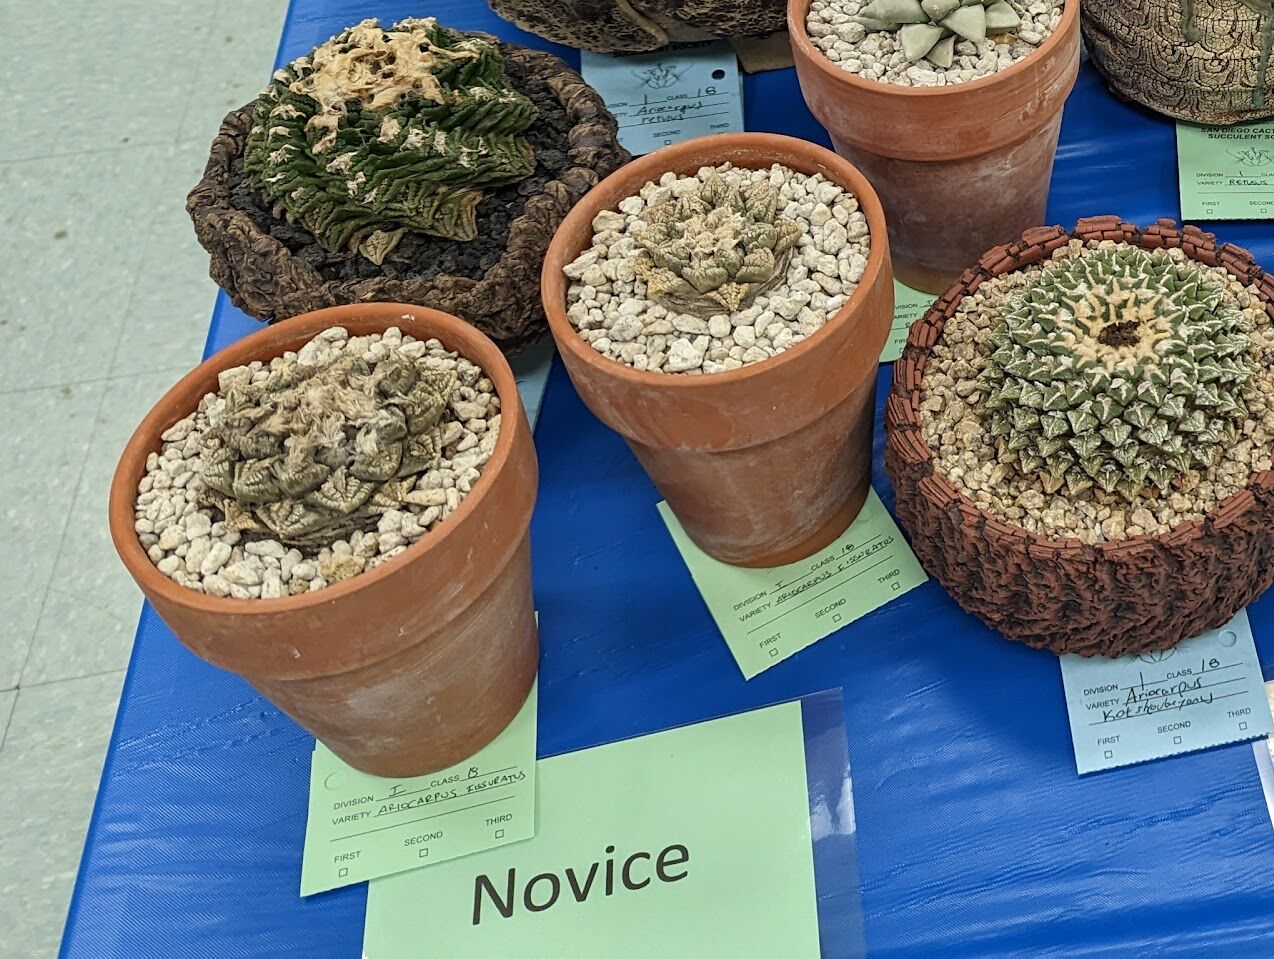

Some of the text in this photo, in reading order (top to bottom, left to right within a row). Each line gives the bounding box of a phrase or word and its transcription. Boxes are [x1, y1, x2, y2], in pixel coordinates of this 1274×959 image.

[653, 122, 731, 138] SECOND THIRD
[733, 590, 768, 612] DIVISION
[810, 554, 836, 573] CLASS
[738, 601, 774, 623] VARIETY
[759, 568, 901, 649] FIRST SECOND THIRD
[1083, 683, 1119, 697] DIVISION
[1166, 667, 1194, 681] CLASS
[1085, 676, 1204, 711] VARIETY Ariocarpus
[1096, 707, 1252, 747] FIRST SECOND THIRD
[331, 771, 526, 826] VARIETY ARIOCARPUS FISSURATUS
[333, 794, 375, 811] DIVISION
[430, 775, 461, 789] CLASS
[333, 813, 513, 864] FIRST SECOND THIRD
[472, 842, 690, 926] Novice
